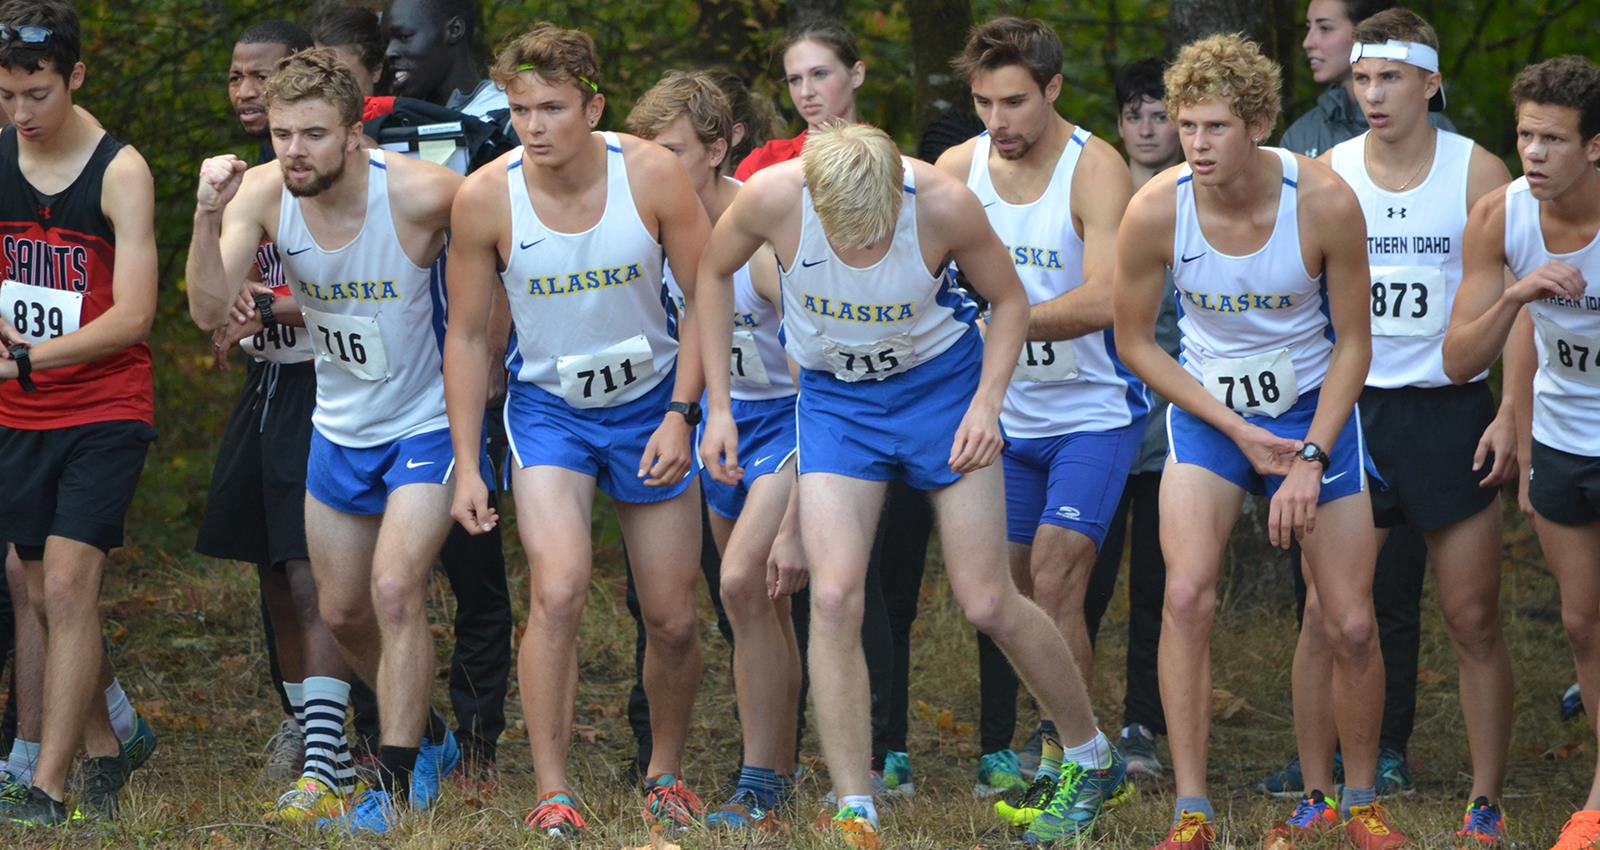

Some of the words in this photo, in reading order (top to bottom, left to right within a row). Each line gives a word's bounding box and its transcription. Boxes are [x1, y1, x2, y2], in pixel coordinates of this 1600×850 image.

[1008, 245, 1064, 270] SKA
[1367, 236, 1408, 254] THERN
[1413, 236, 1451, 254] IDAHO
[3, 235, 88, 293] SAINTS
[528, 262, 641, 297] ALASKA
[298, 279, 400, 302] ALASKA
[1182, 287, 1296, 315] ALASKA
[1371, 282, 1428, 318] 873
[1585, 295, 1600, 311] ID
[14, 300, 63, 339] 839
[802, 292, 916, 324] ALASKA
[317, 325, 367, 365] 716
[838, 348, 899, 374] 715
[1017, 341, 1055, 366] 13
[1557, 339, 1600, 372] 87
[577, 358, 637, 398] 711
[1218, 371, 1280, 409] 718
